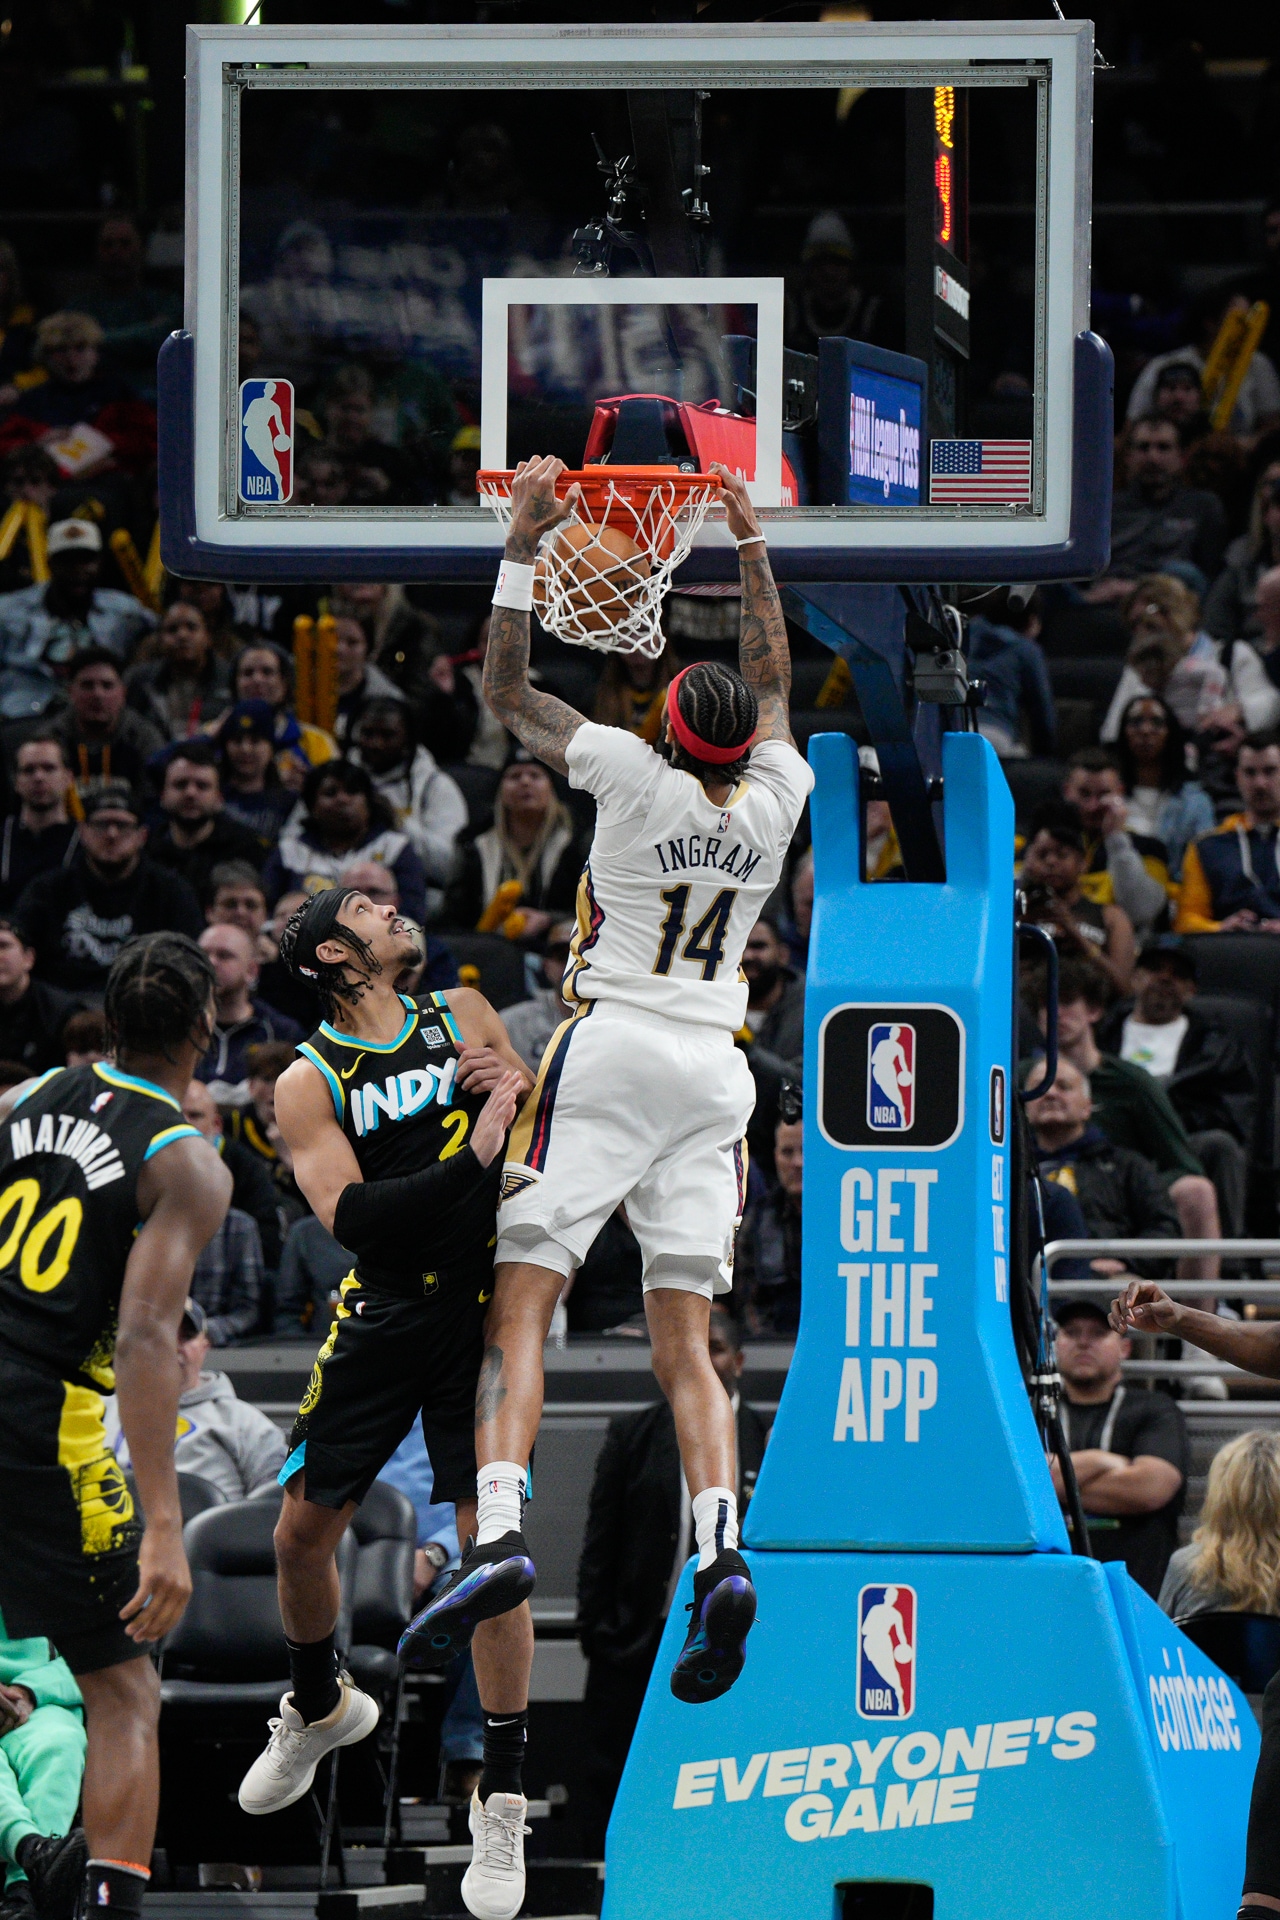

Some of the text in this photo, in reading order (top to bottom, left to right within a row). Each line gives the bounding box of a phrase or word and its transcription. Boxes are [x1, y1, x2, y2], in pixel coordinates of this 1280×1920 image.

[246, 475, 272, 496] NBA
[871, 401, 898, 498] League
[899, 408, 919, 490] Pass
[654, 834, 762, 883] INGRAM
[651, 882, 739, 982] 14
[350, 1057, 459, 1137] INDY
[438, 1109, 469, 1162] 2
[873, 1106, 897, 1124] NBA
[10, 1113, 126, 1191] MATHURIN
[0, 1177, 83, 1293] 00
[839, 1167, 939, 1253] GET
[837, 1262, 939, 1348] THE
[832, 1357, 938, 1443] APP
[865, 1688, 893, 1711] NBA
[1148, 1646, 1242, 1753] coinbase
[672, 1710, 1098, 1810] EVERYONE'S
[784, 1773, 980, 1843] GAME
